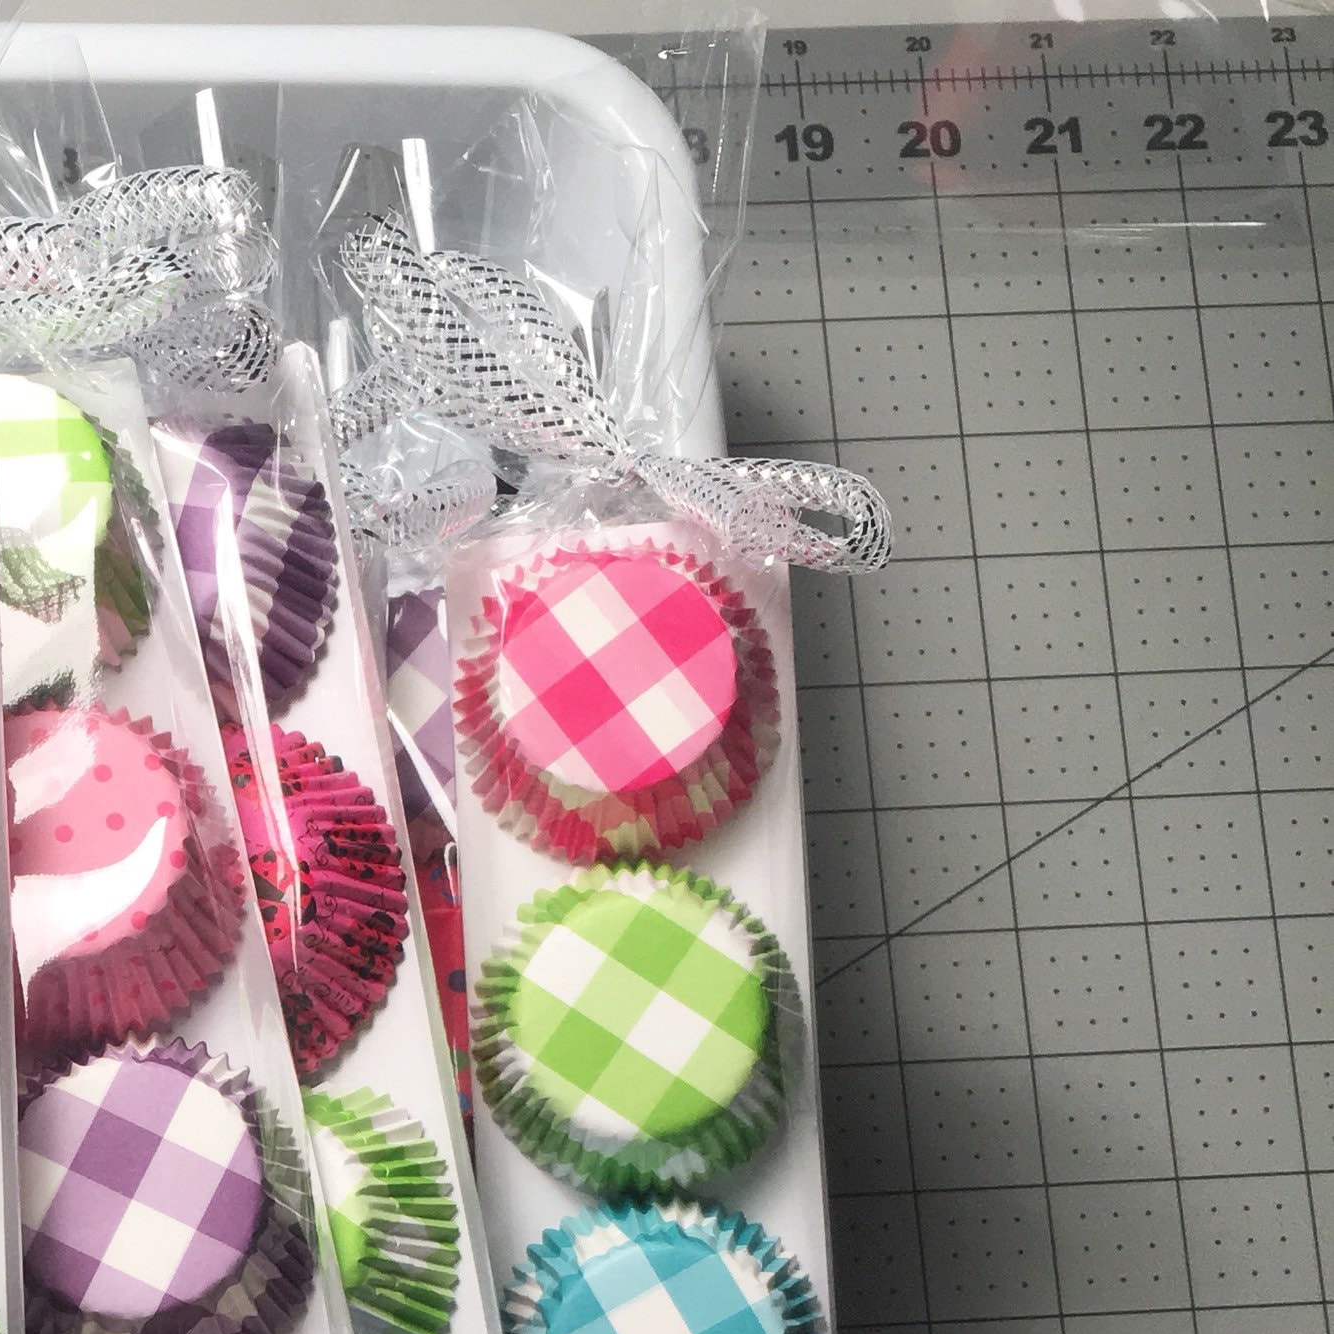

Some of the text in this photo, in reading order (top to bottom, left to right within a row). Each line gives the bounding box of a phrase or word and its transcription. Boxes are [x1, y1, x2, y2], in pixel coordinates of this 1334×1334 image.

[781, 39, 810, 57] 19
[904, 36, 933, 53] 20
[1028, 32, 1055, 50] 21
[1149, 29, 1178, 47] 22
[1270, 26, 1297, 44] 23
[773, 122, 836, 164] 19
[896, 119, 963, 160] 20
[1023, 115, 1084, 155] 21
[1143, 112, 1210, 151] 22
[1265, 109, 1330, 149] 23
